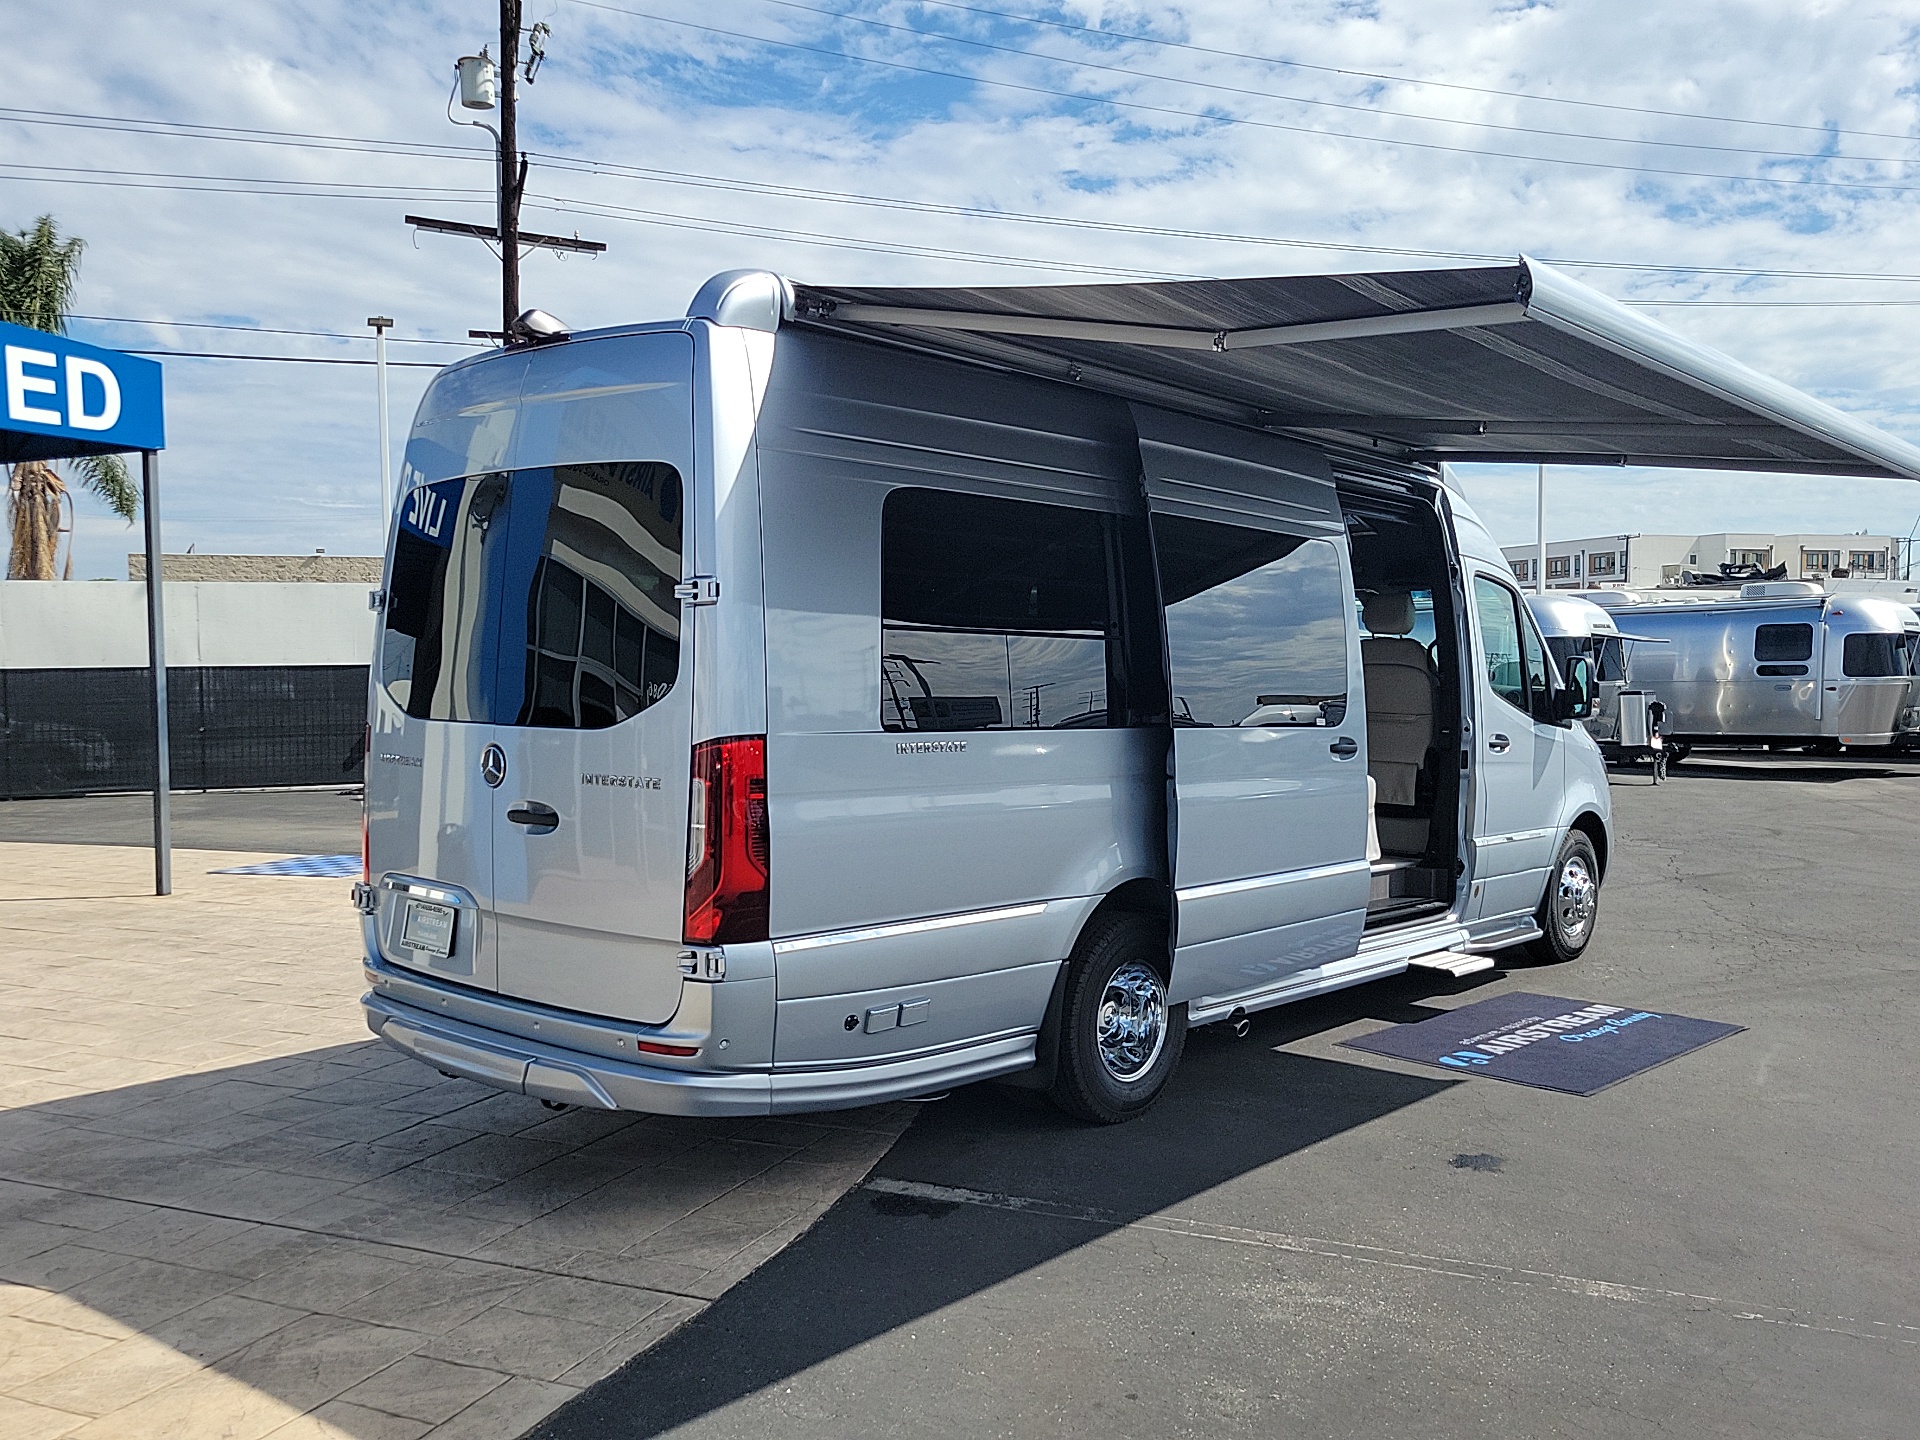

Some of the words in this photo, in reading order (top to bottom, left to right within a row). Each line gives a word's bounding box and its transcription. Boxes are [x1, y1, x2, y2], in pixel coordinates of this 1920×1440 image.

[896, 740, 968, 755] INTERSTATE
[580, 772, 662, 791] INTERSTATE
[1476, 1004, 1626, 1055] AIRSTREAM
